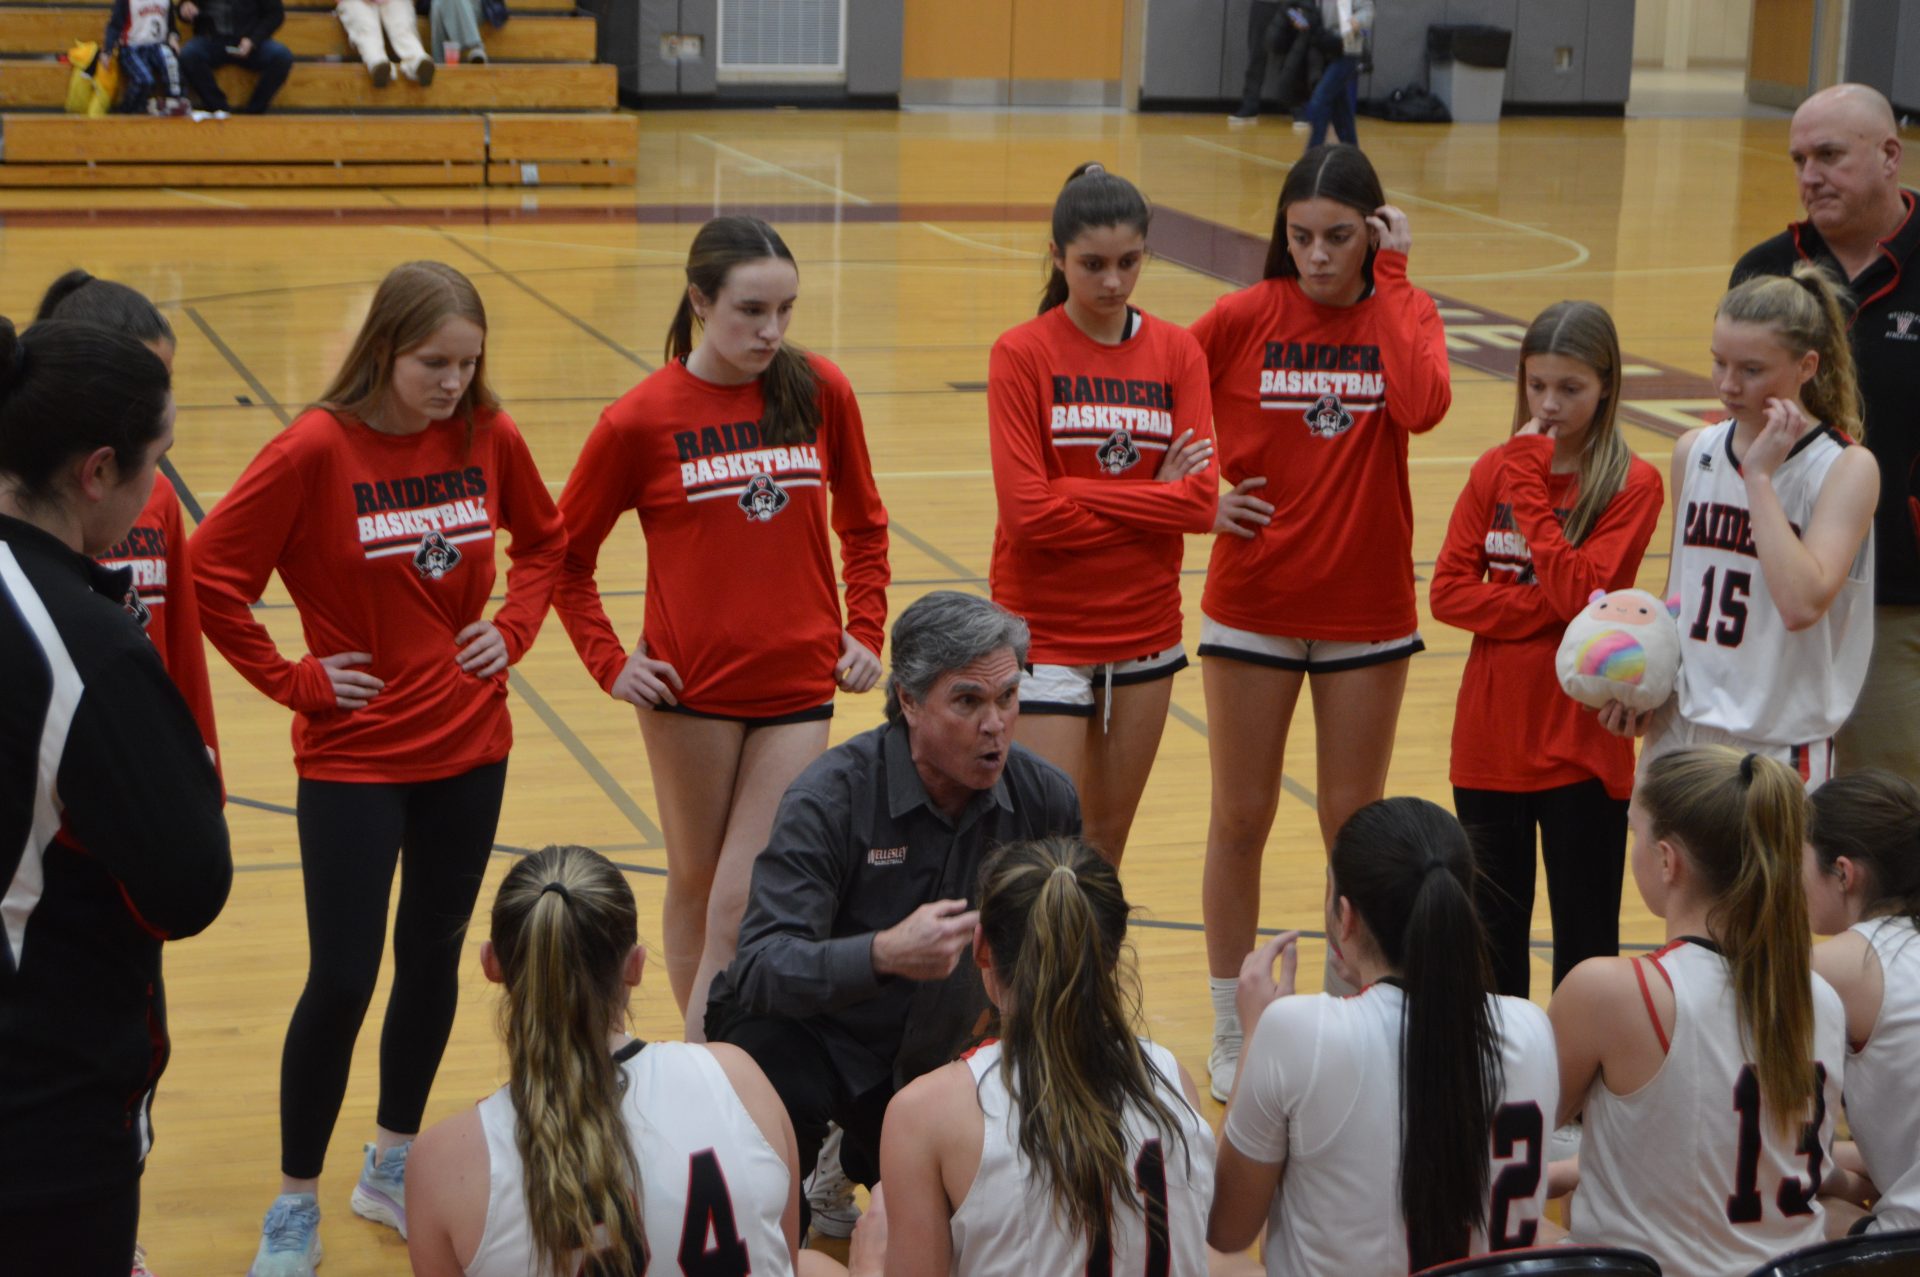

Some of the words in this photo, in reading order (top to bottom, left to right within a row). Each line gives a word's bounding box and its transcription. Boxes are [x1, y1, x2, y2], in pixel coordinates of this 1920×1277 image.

[1263, 341, 1384, 371] RAIDER
[352, 466, 488, 515] RAIDERS
[681, 446, 821, 488] BASKETBALL
[1689, 565, 1751, 649] 15
[1727, 1061, 1827, 1223] 13
